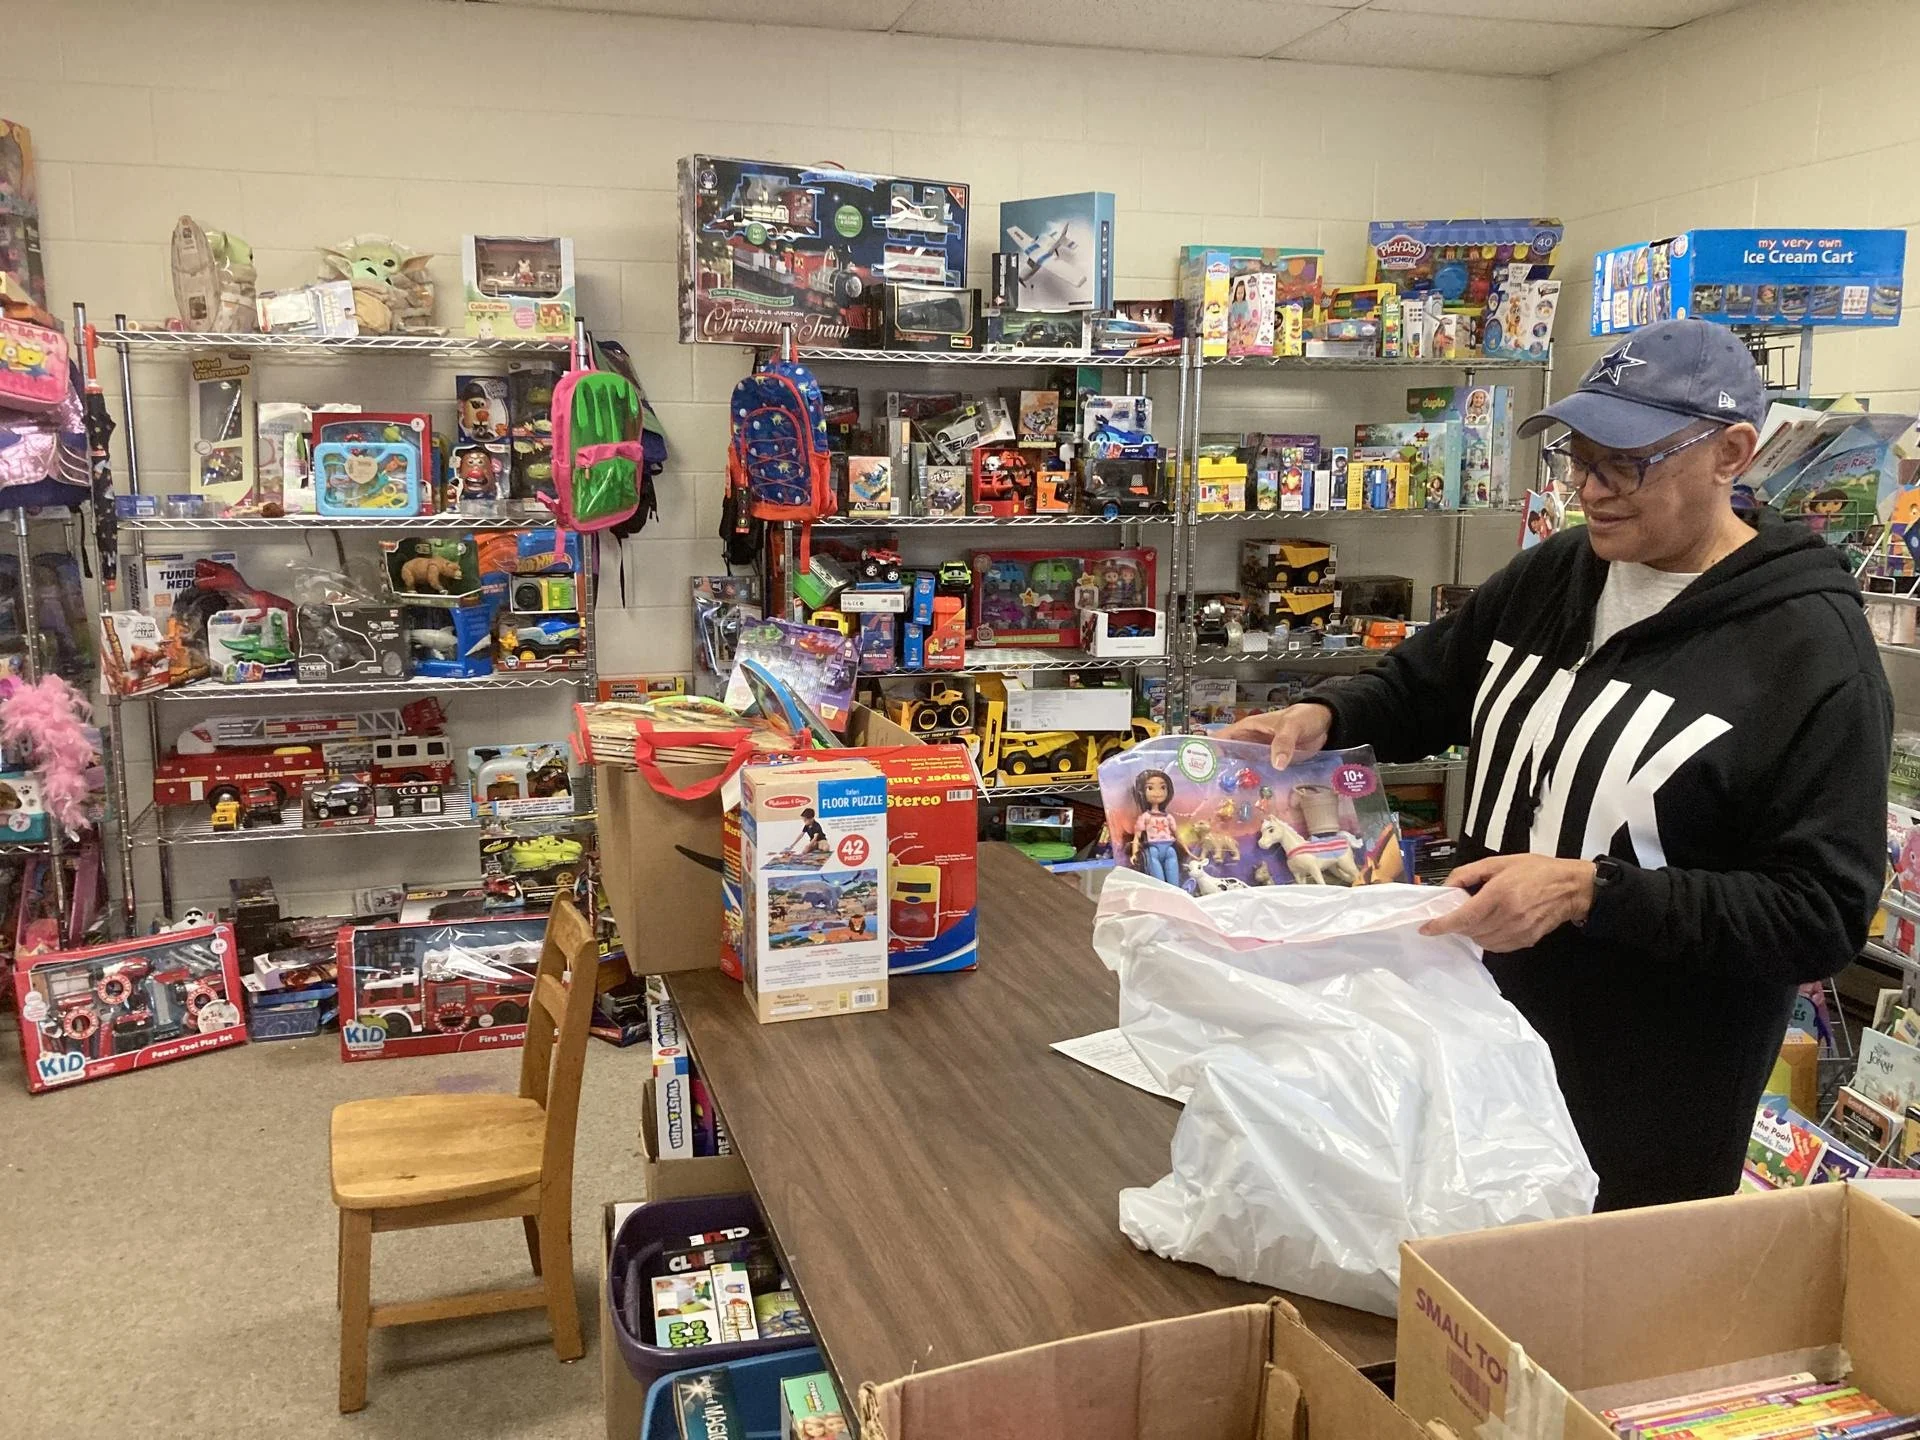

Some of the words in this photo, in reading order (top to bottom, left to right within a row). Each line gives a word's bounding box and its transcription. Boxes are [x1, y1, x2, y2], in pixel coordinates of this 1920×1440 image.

[1378, 240, 1422, 257] Play-Doh
[1537, 237, 1553, 248] 40
[1758, 238, 1777, 249] my
[1782, 238, 1814, 248] very
[1818, 238, 1842, 248] own
[1744, 250, 1766, 264] Ice
[1768, 250, 1818, 264] Cream
[1821, 250, 1854, 264] Cart
[799, 313, 850, 344] Train
[192, 358, 222, 369] Wind
[159, 570, 196, 581] TUMB
[234, 772, 257, 780] FIRE
[259, 770, 284, 779] RESCUE
[1343, 770, 1364, 782] 10+
[822, 799, 850, 810] FLOOR
[852, 794, 884, 807] PUZZLE
[886, 795, 942, 808] Stereo
[841, 840, 864, 856] 42
[346, 1027, 384, 1043] KID
[478, 1035, 498, 1043] Fire
[152, 1048, 179, 1059] Power
[180, 1042, 199, 1052] Tool
[200, 1038, 218, 1050] Play
[218, 1033, 233, 1044] Set
[40, 1054, 84, 1077] KID
[1756, 1120, 1770, 1132] the
[1770, 1128, 1791, 1144] Pooh
[689, 1227, 750, 1247] CLUE
[668, 1250, 716, 1272] CLUE
[1416, 1288, 1472, 1360] SMALL
